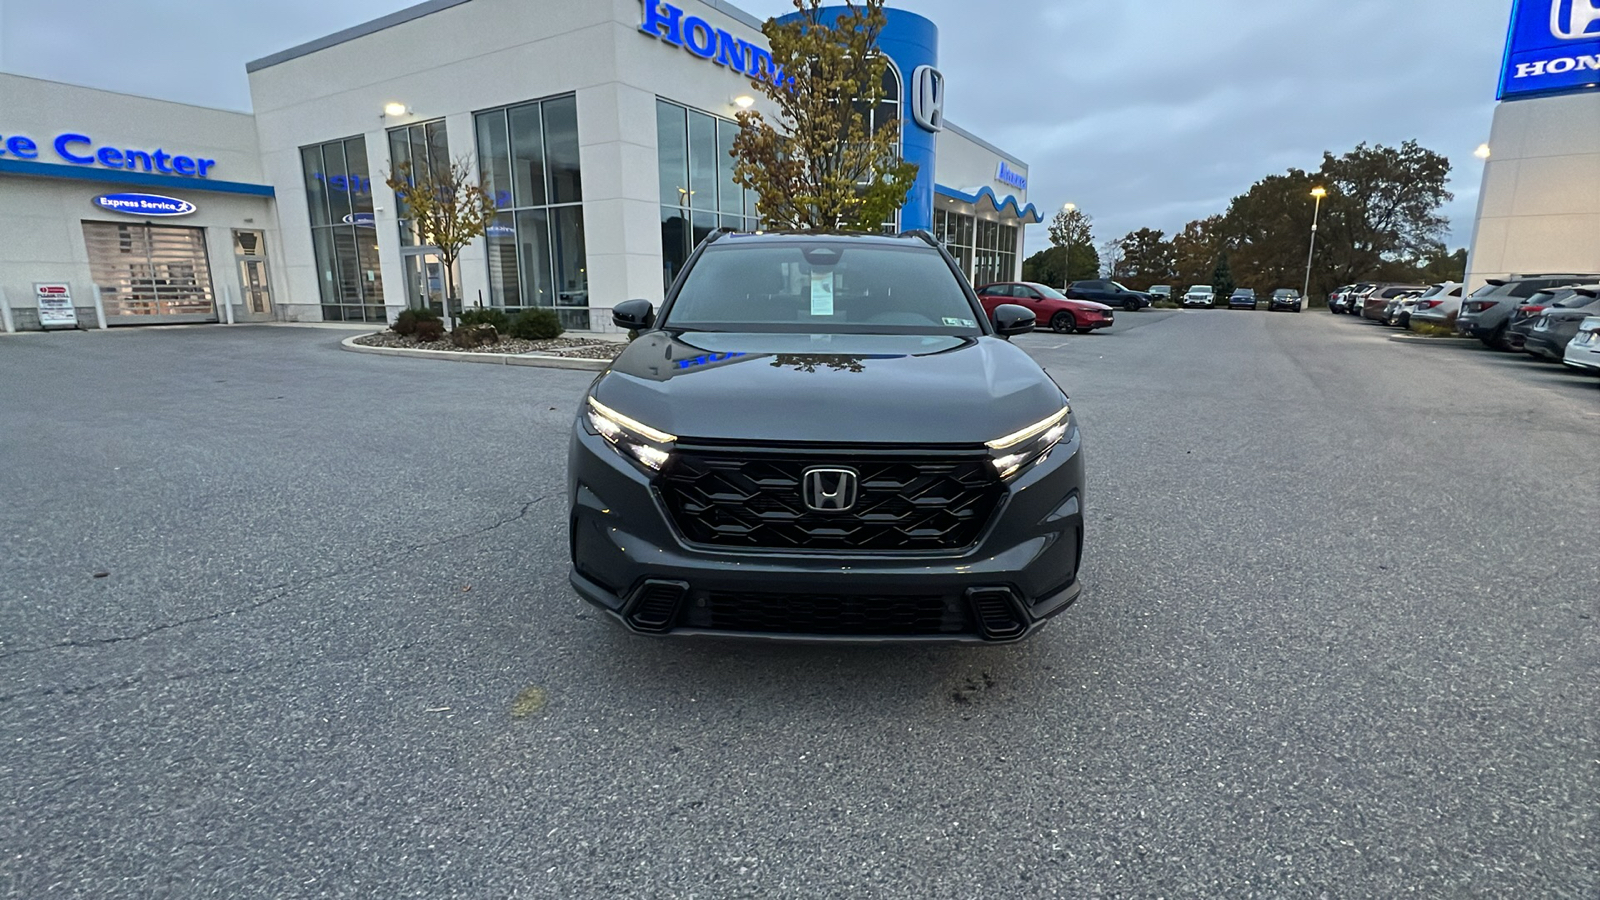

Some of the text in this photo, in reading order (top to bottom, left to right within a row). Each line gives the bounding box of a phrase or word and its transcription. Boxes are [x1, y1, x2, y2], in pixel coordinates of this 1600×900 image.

[0, 133, 215, 177] e Center
[100, 197, 176, 210] Express Service
